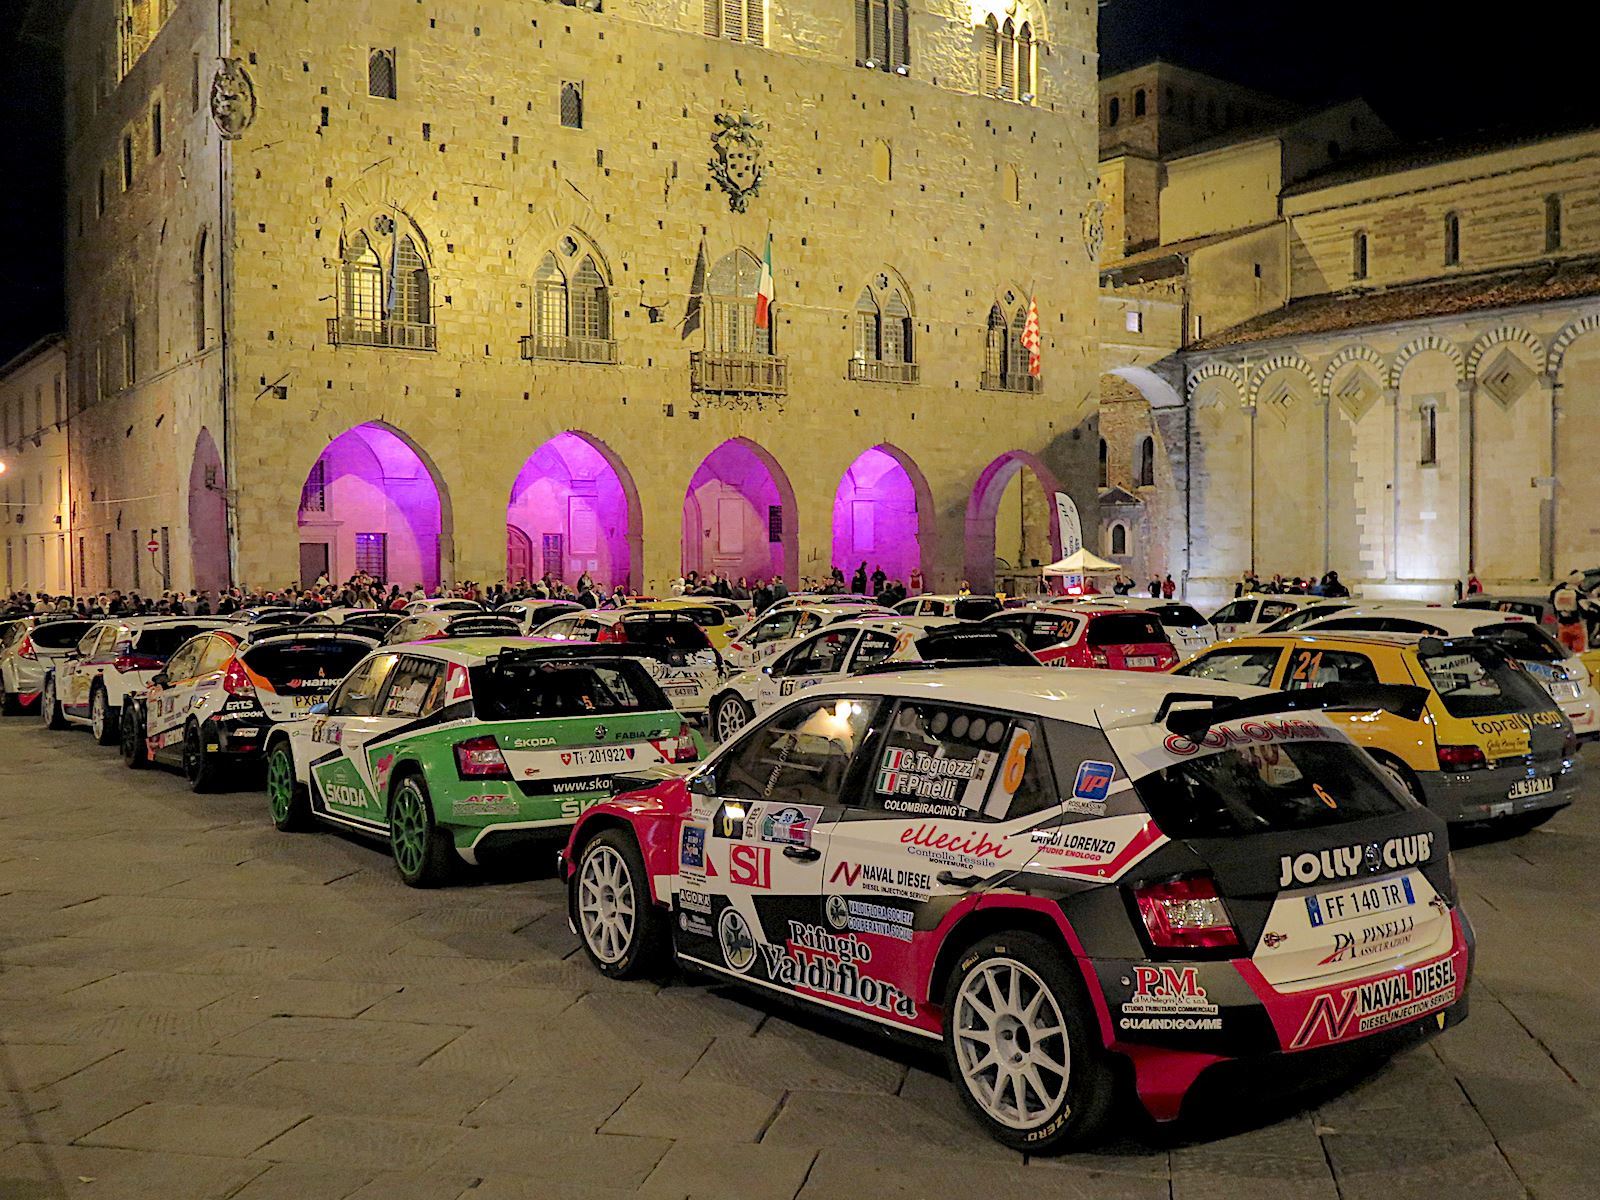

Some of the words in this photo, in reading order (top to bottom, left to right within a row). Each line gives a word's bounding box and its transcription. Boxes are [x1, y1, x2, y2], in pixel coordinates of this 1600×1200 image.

[1057, 620, 1074, 638] 29
[1293, 652, 1324, 681] 21
[581, 695, 594, 709] 5
[615, 731, 646, 741] FABIA
[1471, 710, 1563, 736] toprally.com
[514, 736, 557, 748] ŠKODA
[900, 750, 978, 780] G.Tognozzi
[1003, 730, 1032, 795] 6
[326, 779, 369, 809] ŠKODA
[897, 774, 958, 801] F.Pinelli
[1078, 774, 1110, 793] IP
[1312, 783, 1338, 809] 6
[561, 797, 611, 819] ŠK
[900, 822, 1014, 860] ellecibi
[1038, 846, 1064, 856] STUDIO
[1064, 849, 1102, 861] ENOLOGO
[1065, 834, 1116, 854] LORENZO
[730, 843, 772, 889] SI
[907, 845, 956, 866] Controllo
[957, 854, 996, 869] Tessile
[1280, 845, 1362, 887] JOLLY
[862, 882, 880, 892] DIESEL
[881, 884, 909, 897] INJECTION
[863, 864, 895, 885] NAVAL
[897, 867, 932, 892] DIESEL
[680, 888, 711, 907] AGORA
[1325, 895, 1345, 919] FF
[1350, 888, 1380, 913] 140
[1382, 884, 1402, 906] TR
[788, 920, 872, 963] Rifugio
[1362, 916, 1414, 944] PINELLI
[758, 943, 918, 1019] Valdiflora
[1133, 966, 1207, 997] P.M.
[1360, 976, 1411, 1014] NAVAL
[1414, 959, 1455, 997] DIESEL
[1361, 1014, 1390, 1032] DIESEL
[1390, 1001, 1429, 1020] INJECTION
[1429, 988, 1456, 1007] SERVICE
